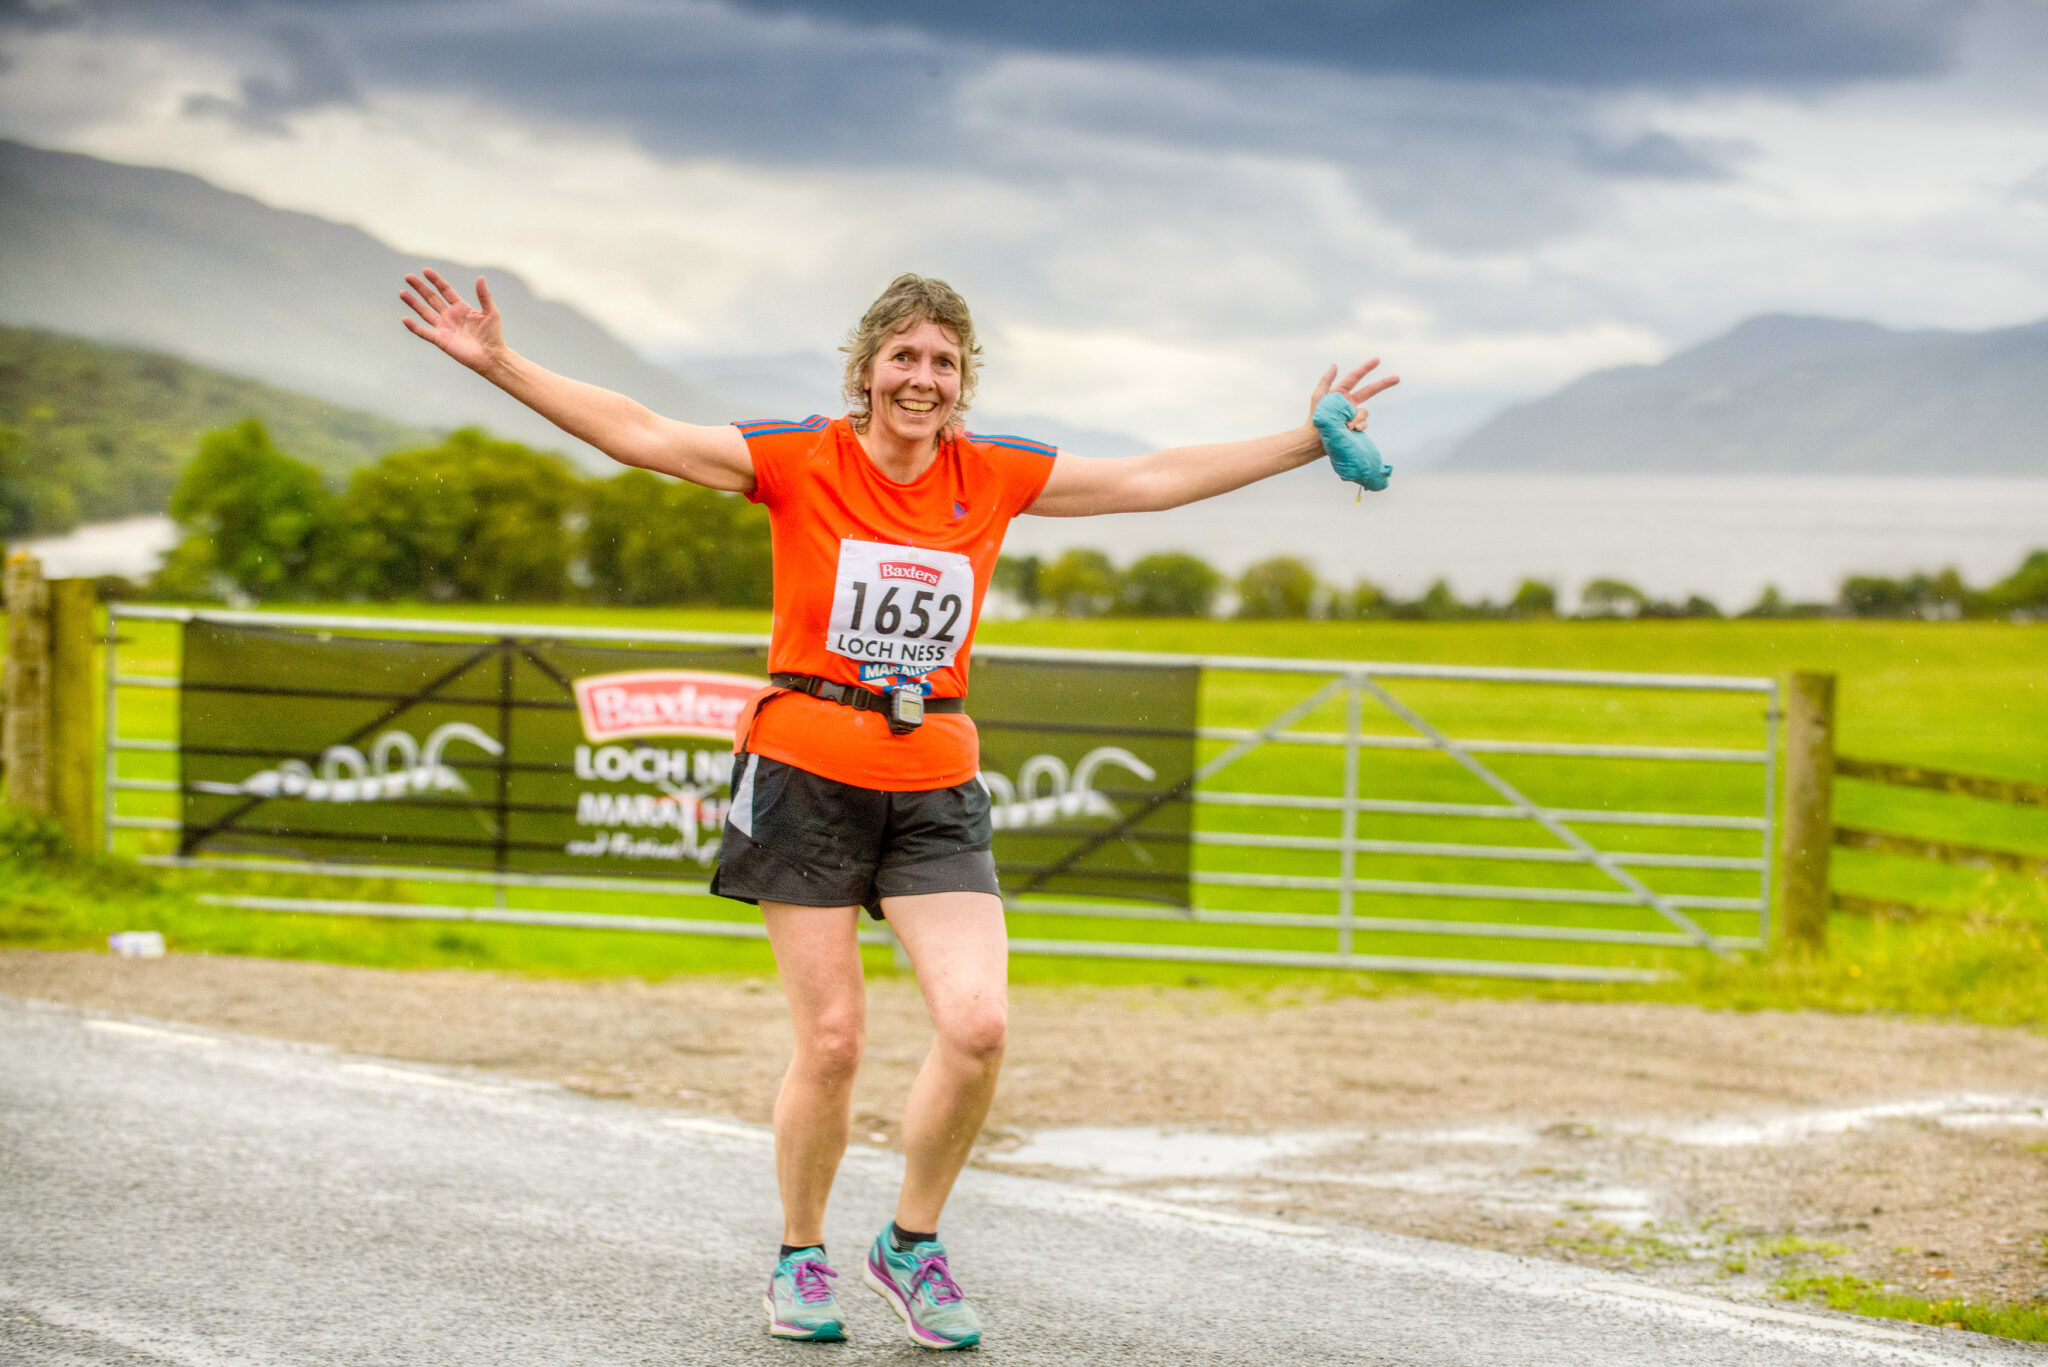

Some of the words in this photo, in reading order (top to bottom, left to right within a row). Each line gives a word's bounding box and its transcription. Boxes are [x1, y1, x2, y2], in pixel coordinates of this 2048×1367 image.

[881, 563, 939, 585] Baxters
[850, 581, 962, 643] 1652
[837, 634, 894, 659] LOCH
[901, 643, 947, 662] NESS
[591, 684, 748, 728] Baxter
[574, 744, 688, 784] LOCH
